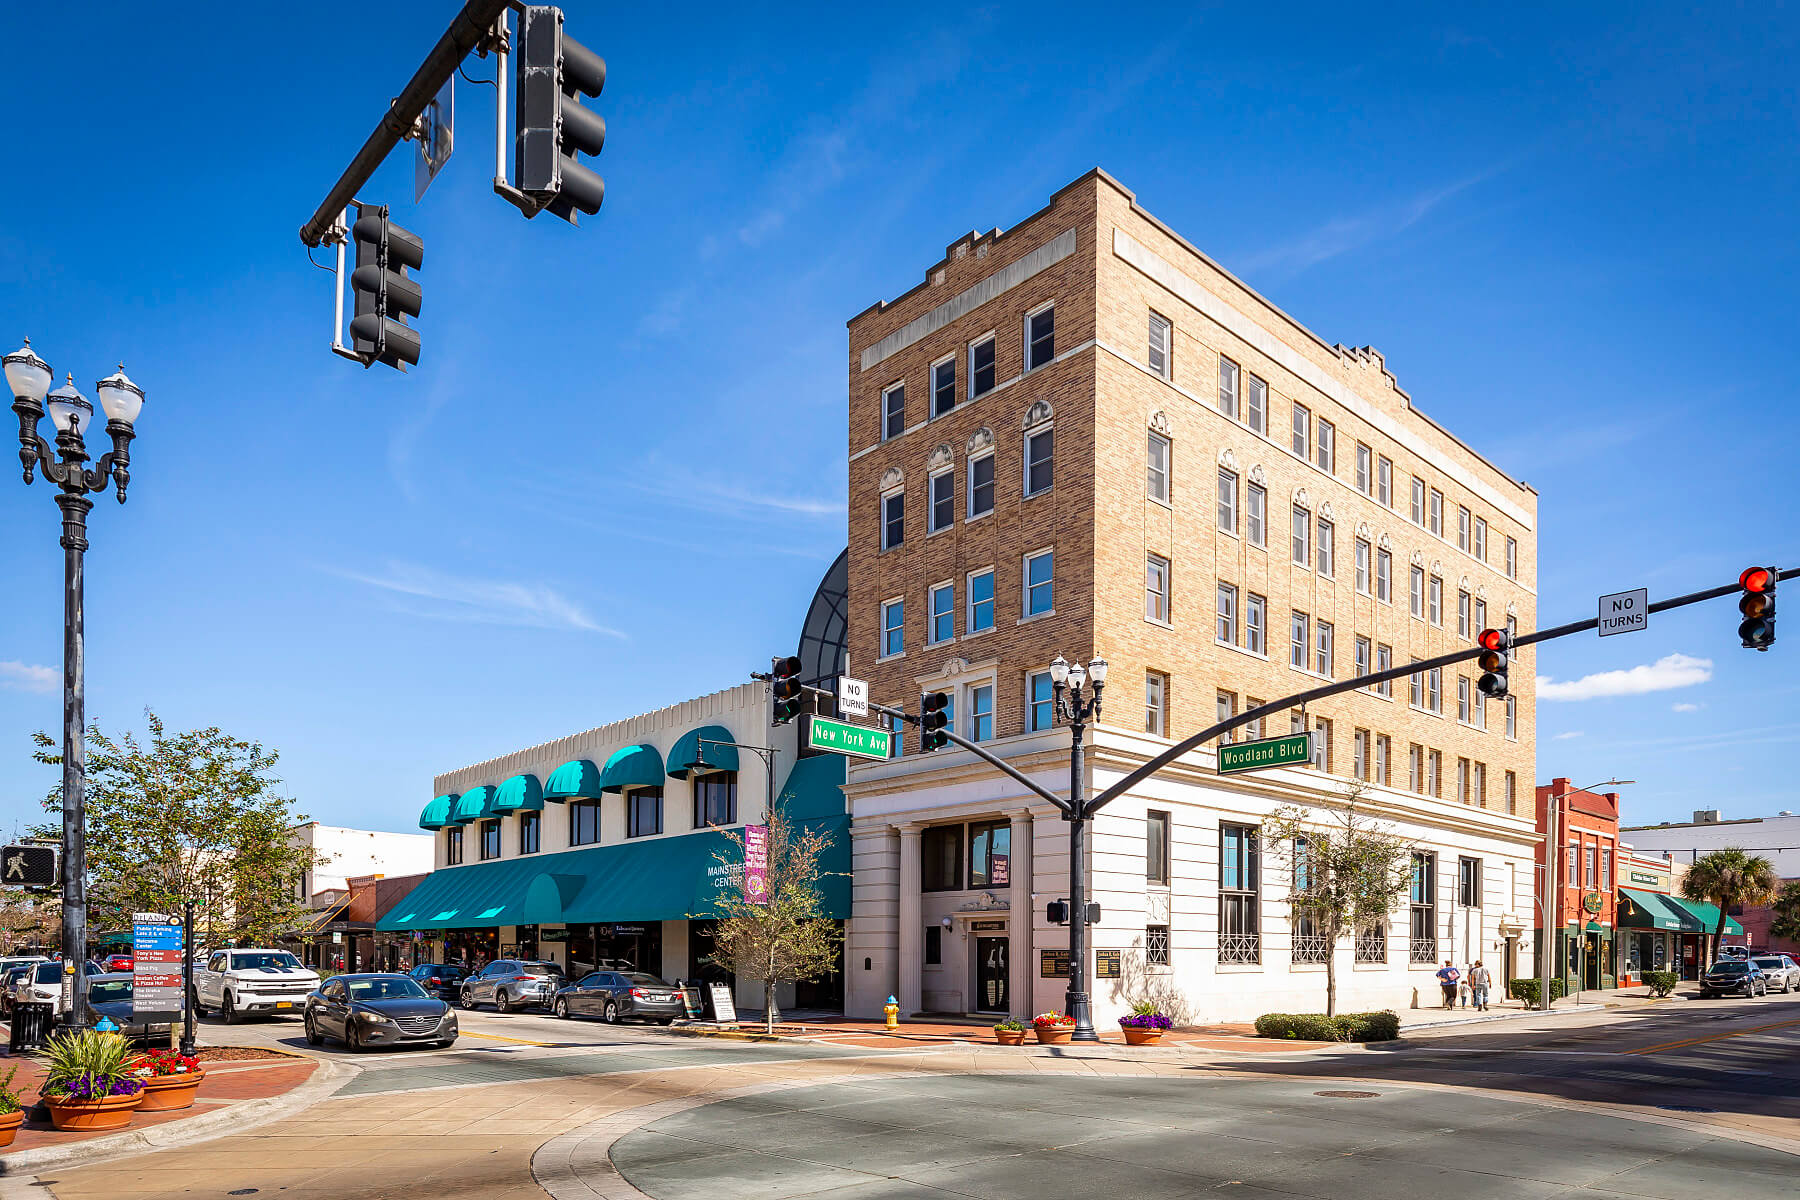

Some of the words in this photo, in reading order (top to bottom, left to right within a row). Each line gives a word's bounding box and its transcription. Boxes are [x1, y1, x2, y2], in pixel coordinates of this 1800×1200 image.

[1612, 597, 1634, 612] NO
[1602, 613, 1643, 629] TURNS
[847, 684, 860, 696] NO
[841, 697, 866, 710] TURNS
[815, 724, 836, 742] New
[842, 729, 864, 747] York
[869, 735, 886, 751] Ave
[1224, 746, 1274, 764] Woodland
[1280, 742, 1303, 757] Blvd
[707, 863, 746, 877] MAINSTREE
